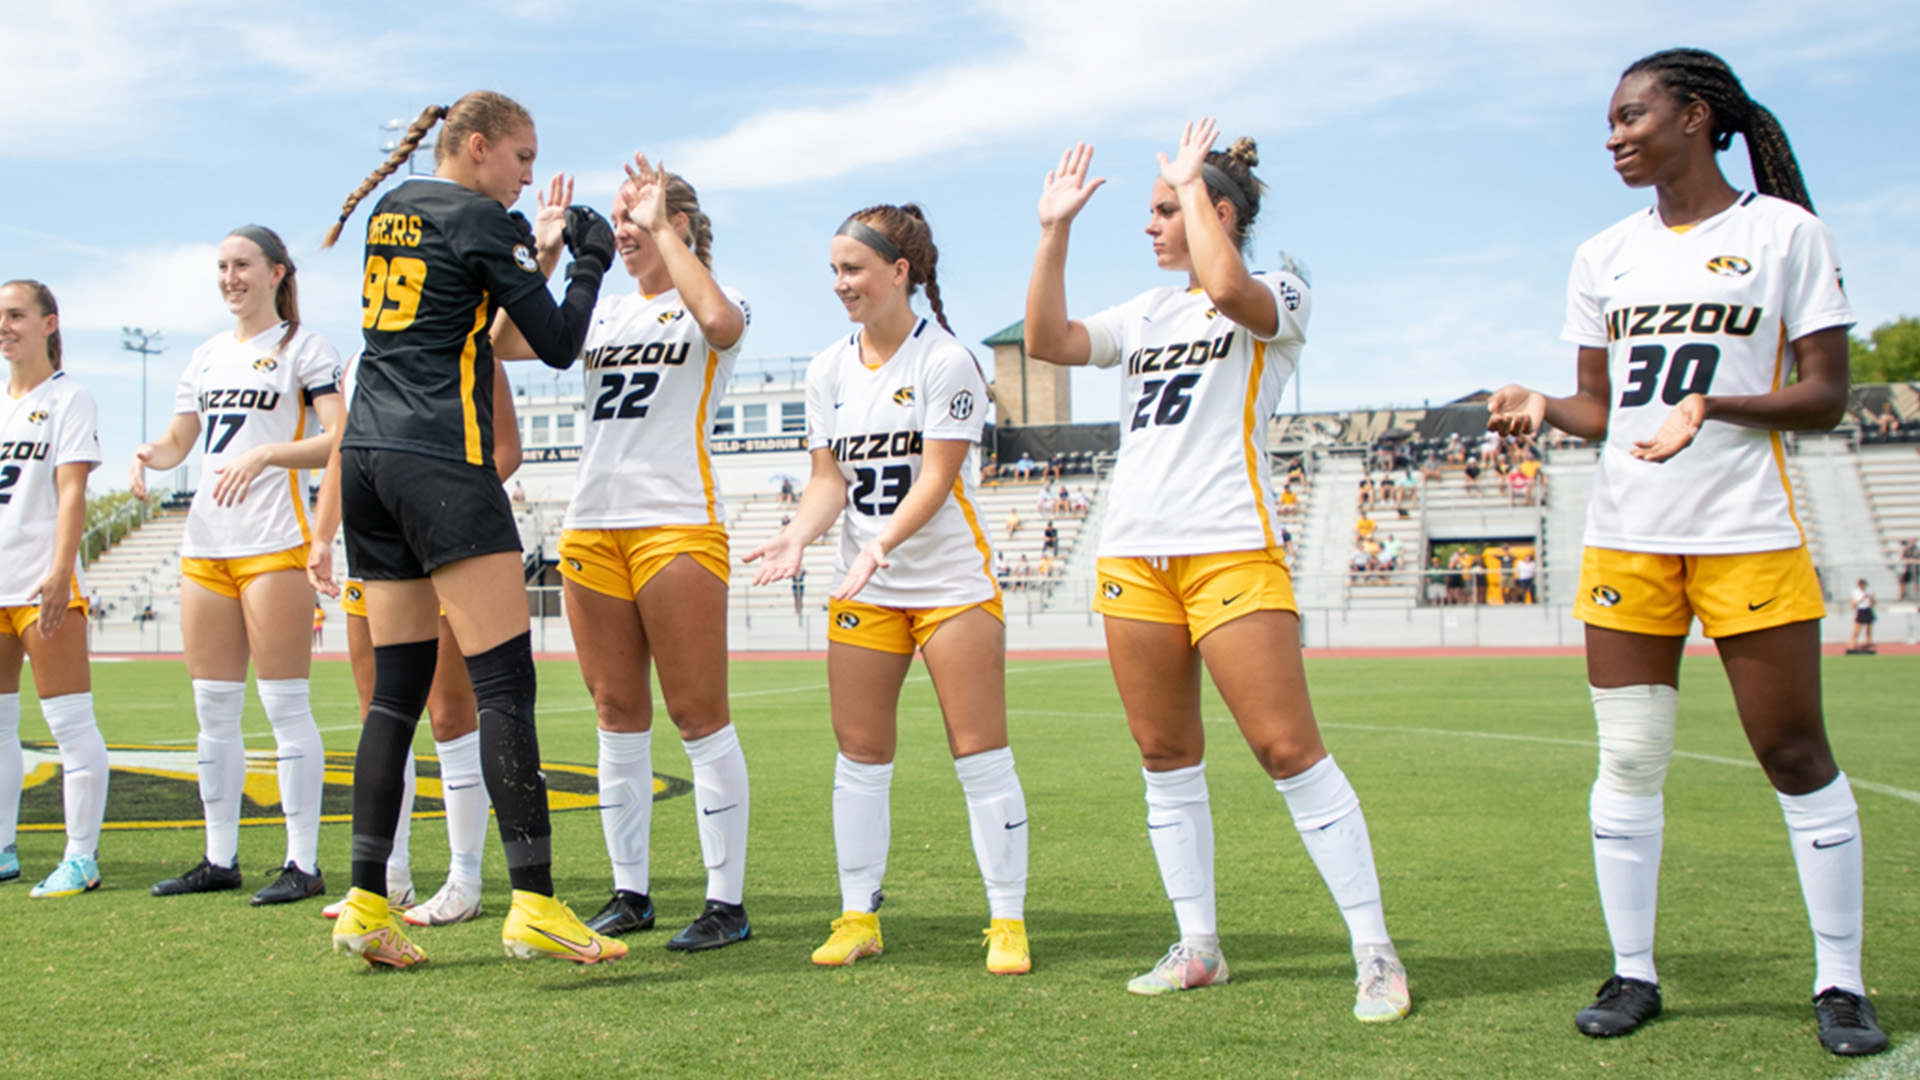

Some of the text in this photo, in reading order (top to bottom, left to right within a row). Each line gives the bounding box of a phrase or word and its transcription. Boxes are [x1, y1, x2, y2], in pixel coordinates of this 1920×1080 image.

[362, 255, 427, 332] 99
[592, 371, 660, 421] 22
[1130, 373, 1202, 433] 26
[1619, 343, 1721, 408] 30
[204, 413, 248, 455] 17
[853, 464, 912, 516] 23
